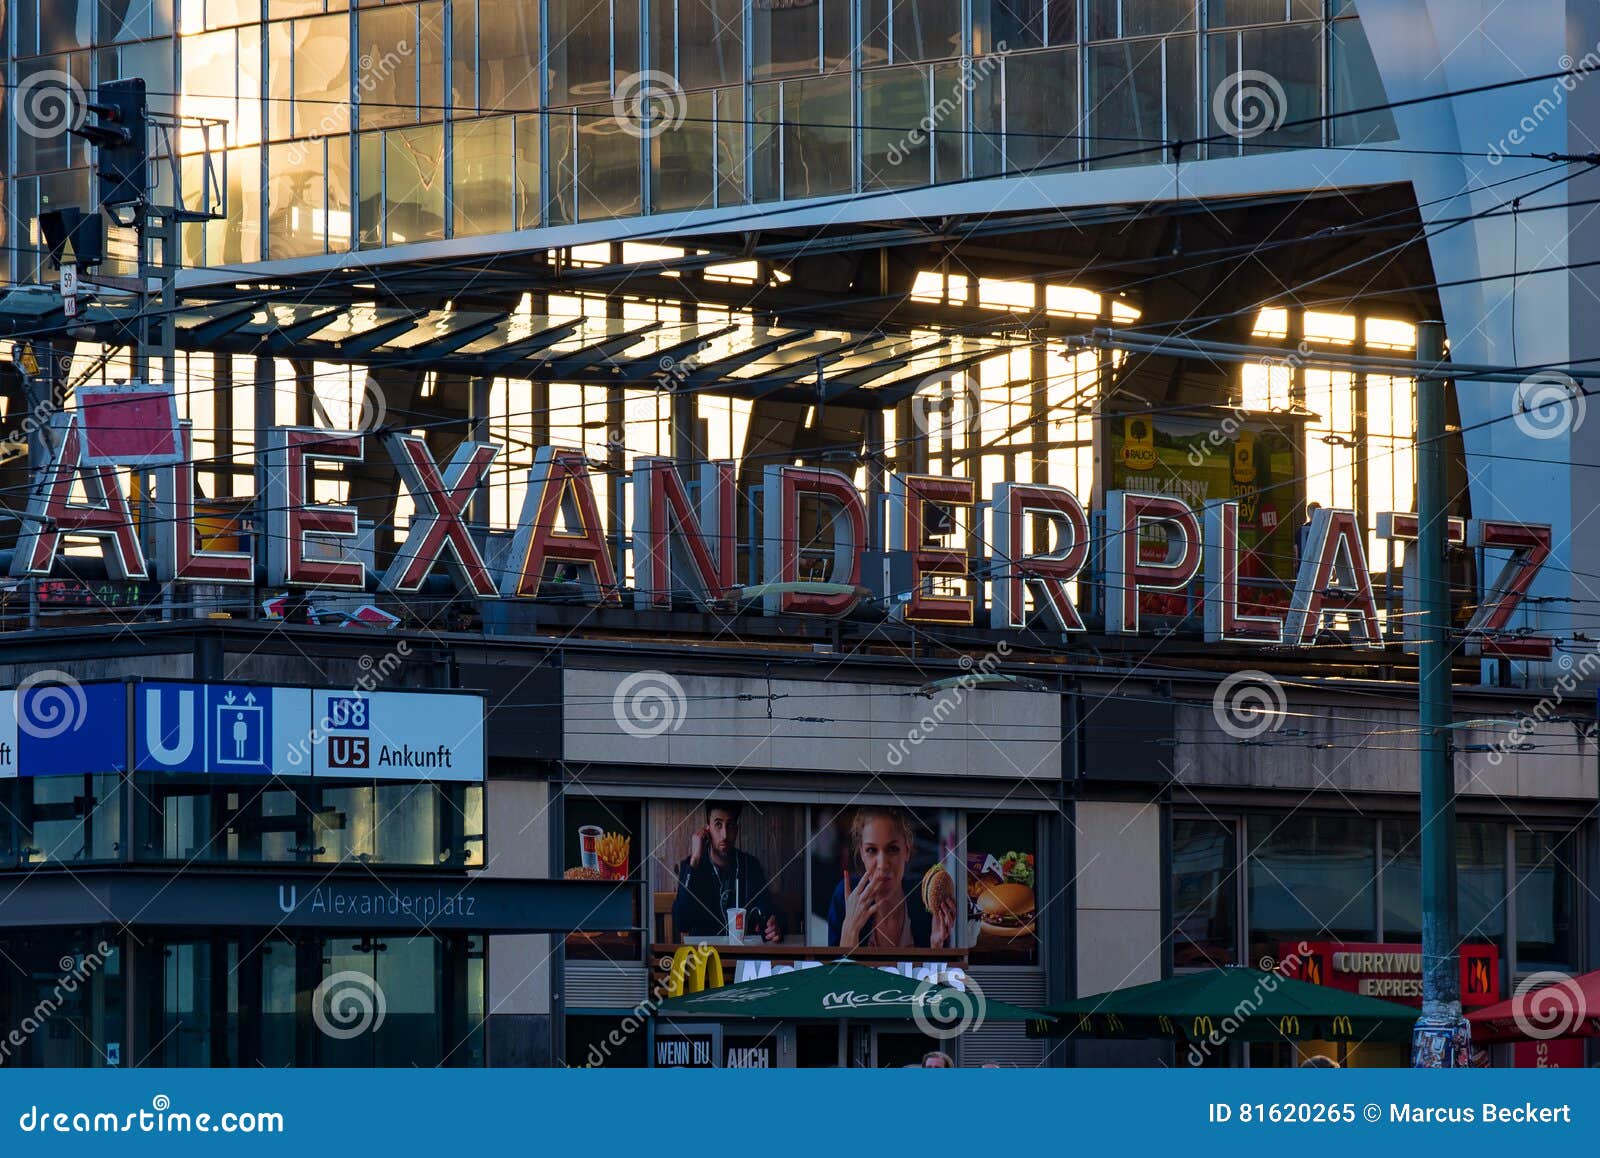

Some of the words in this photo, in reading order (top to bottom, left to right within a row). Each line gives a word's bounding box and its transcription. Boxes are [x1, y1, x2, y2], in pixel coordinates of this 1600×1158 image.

[333, 701, 366, 727] U8
[146, 689, 194, 766] U
[333, 739, 366, 765] U5
[378, 744, 452, 768] Ankunft
[279, 885, 296, 913] U
[311, 887, 476, 921] Alexanderplatz
[1341, 953, 1423, 973] CURRYWU
[657, 1041, 690, 1065] WENN
[693, 1041, 710, 1065] DU
[727, 1047, 769, 1067] AUCH
